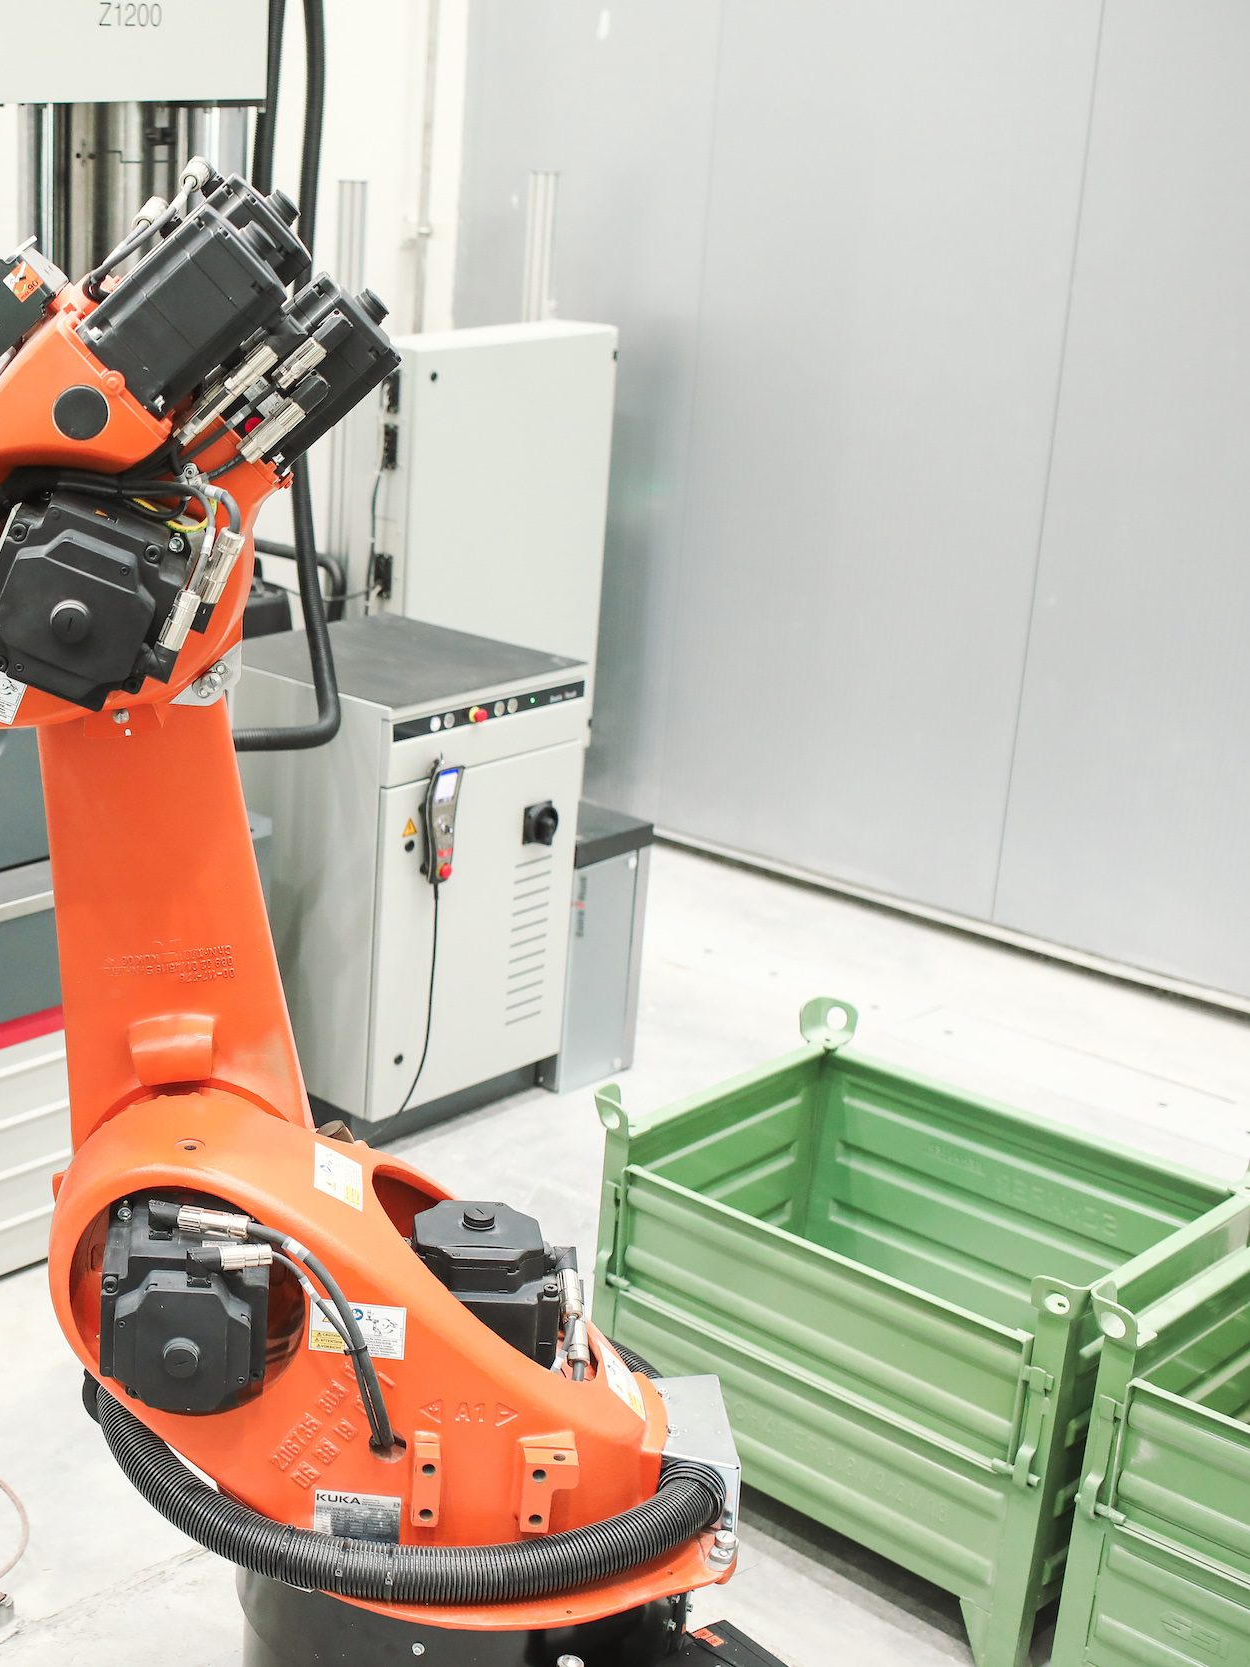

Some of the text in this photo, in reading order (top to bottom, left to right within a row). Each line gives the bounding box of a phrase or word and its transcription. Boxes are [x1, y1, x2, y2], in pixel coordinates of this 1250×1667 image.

[98, 2, 162, 27] Z1200
[454, 1401, 487, 1423] A1
[316, 1493, 361, 1504] KUKA
